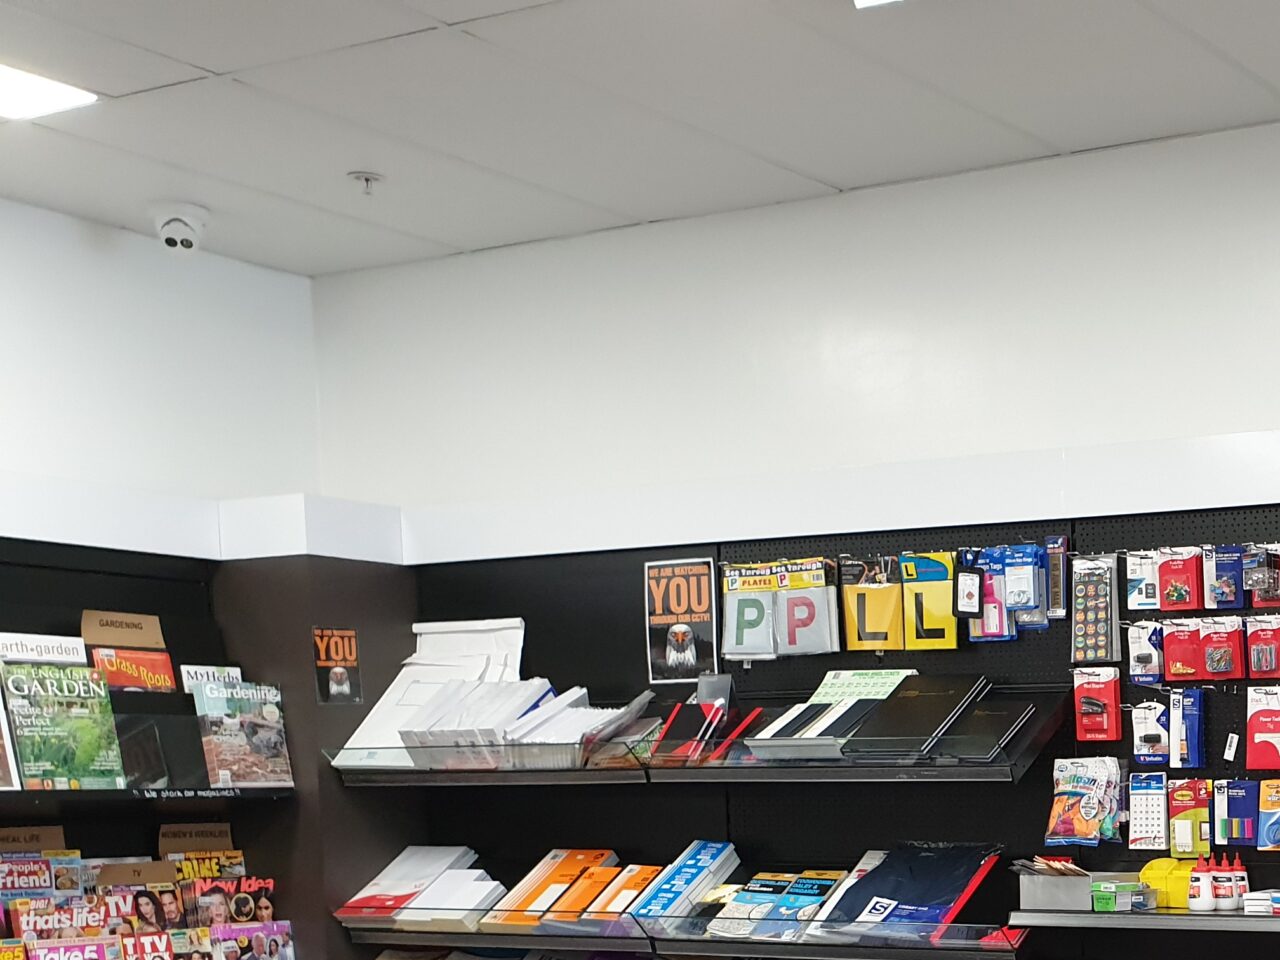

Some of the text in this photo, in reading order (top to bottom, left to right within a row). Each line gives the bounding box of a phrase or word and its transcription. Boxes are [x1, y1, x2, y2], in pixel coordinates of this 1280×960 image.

[648, 575, 711, 616] YOU
[99, 619, 143, 631] GARDENING
[735, 598, 767, 646] P
[786, 596, 817, 647] P
[857, 592, 889, 642] L
[914, 592, 946, 641] L
[314, 635, 358, 662] YOU
[7, 675, 106, 698] GARDEN
[204, 683, 281, 703] Gardening
[132, 868, 143, 878] TV
[139, 935, 169, 955] TV
